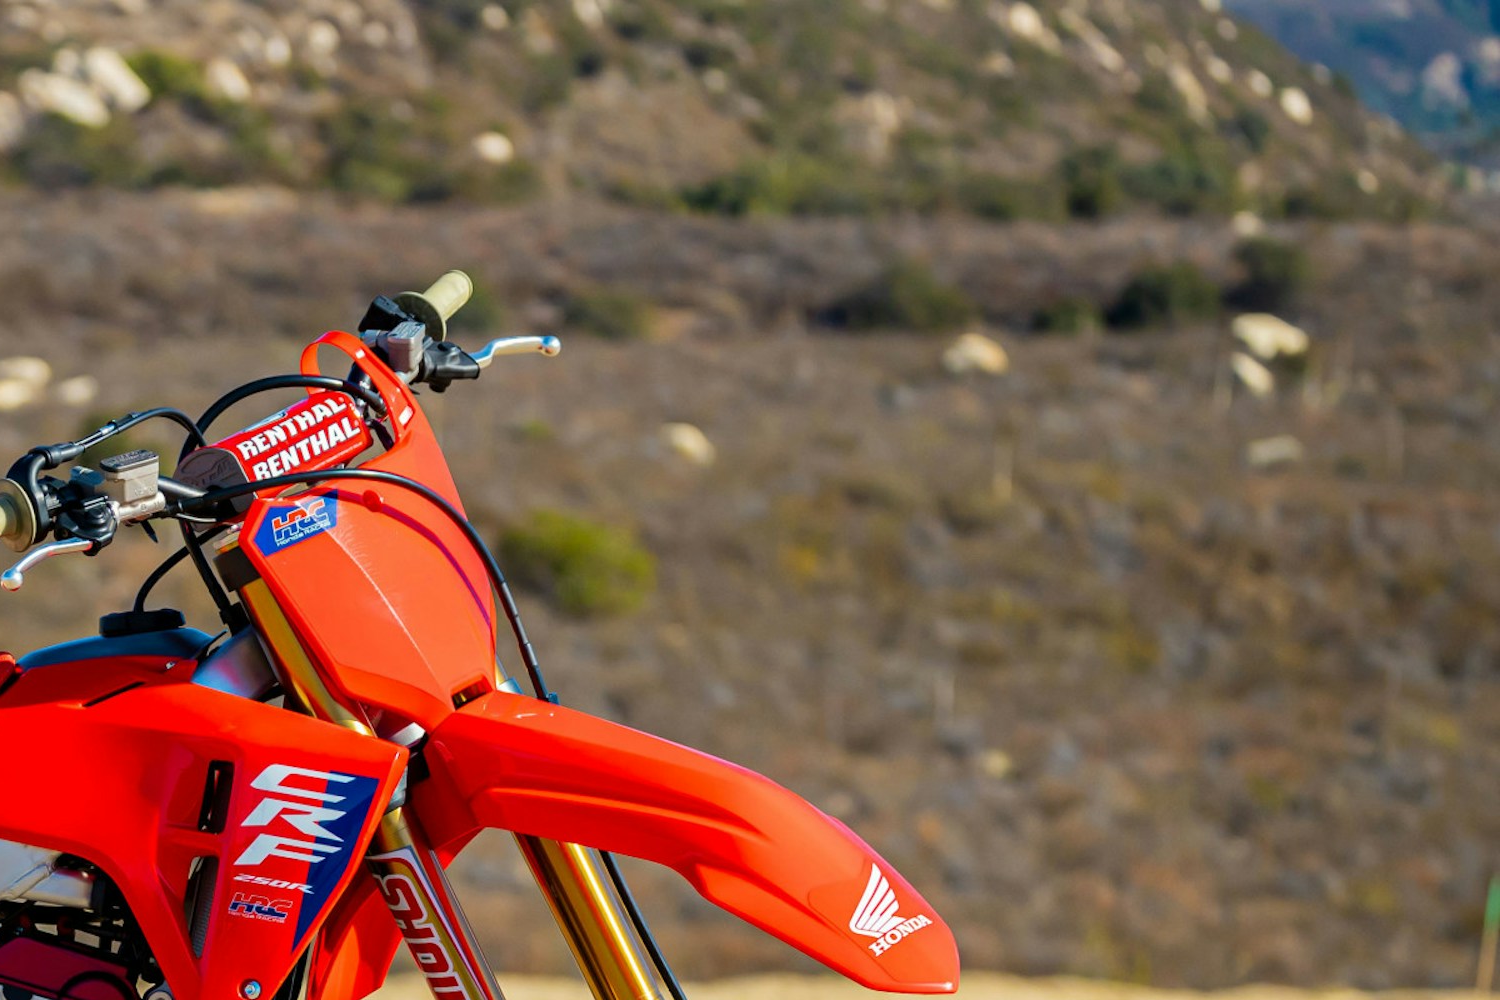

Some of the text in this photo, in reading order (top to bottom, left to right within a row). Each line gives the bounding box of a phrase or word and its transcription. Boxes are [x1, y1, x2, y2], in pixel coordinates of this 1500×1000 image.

[236, 396, 348, 460] RENTHAL
[252, 416, 361, 481] RENTHAL
[272, 498, 329, 541] HRC
[233, 763, 357, 866] CRF
[228, 892, 294, 919] HRC
[233, 873, 315, 895] 250R
[868, 914, 933, 957] HONDA
